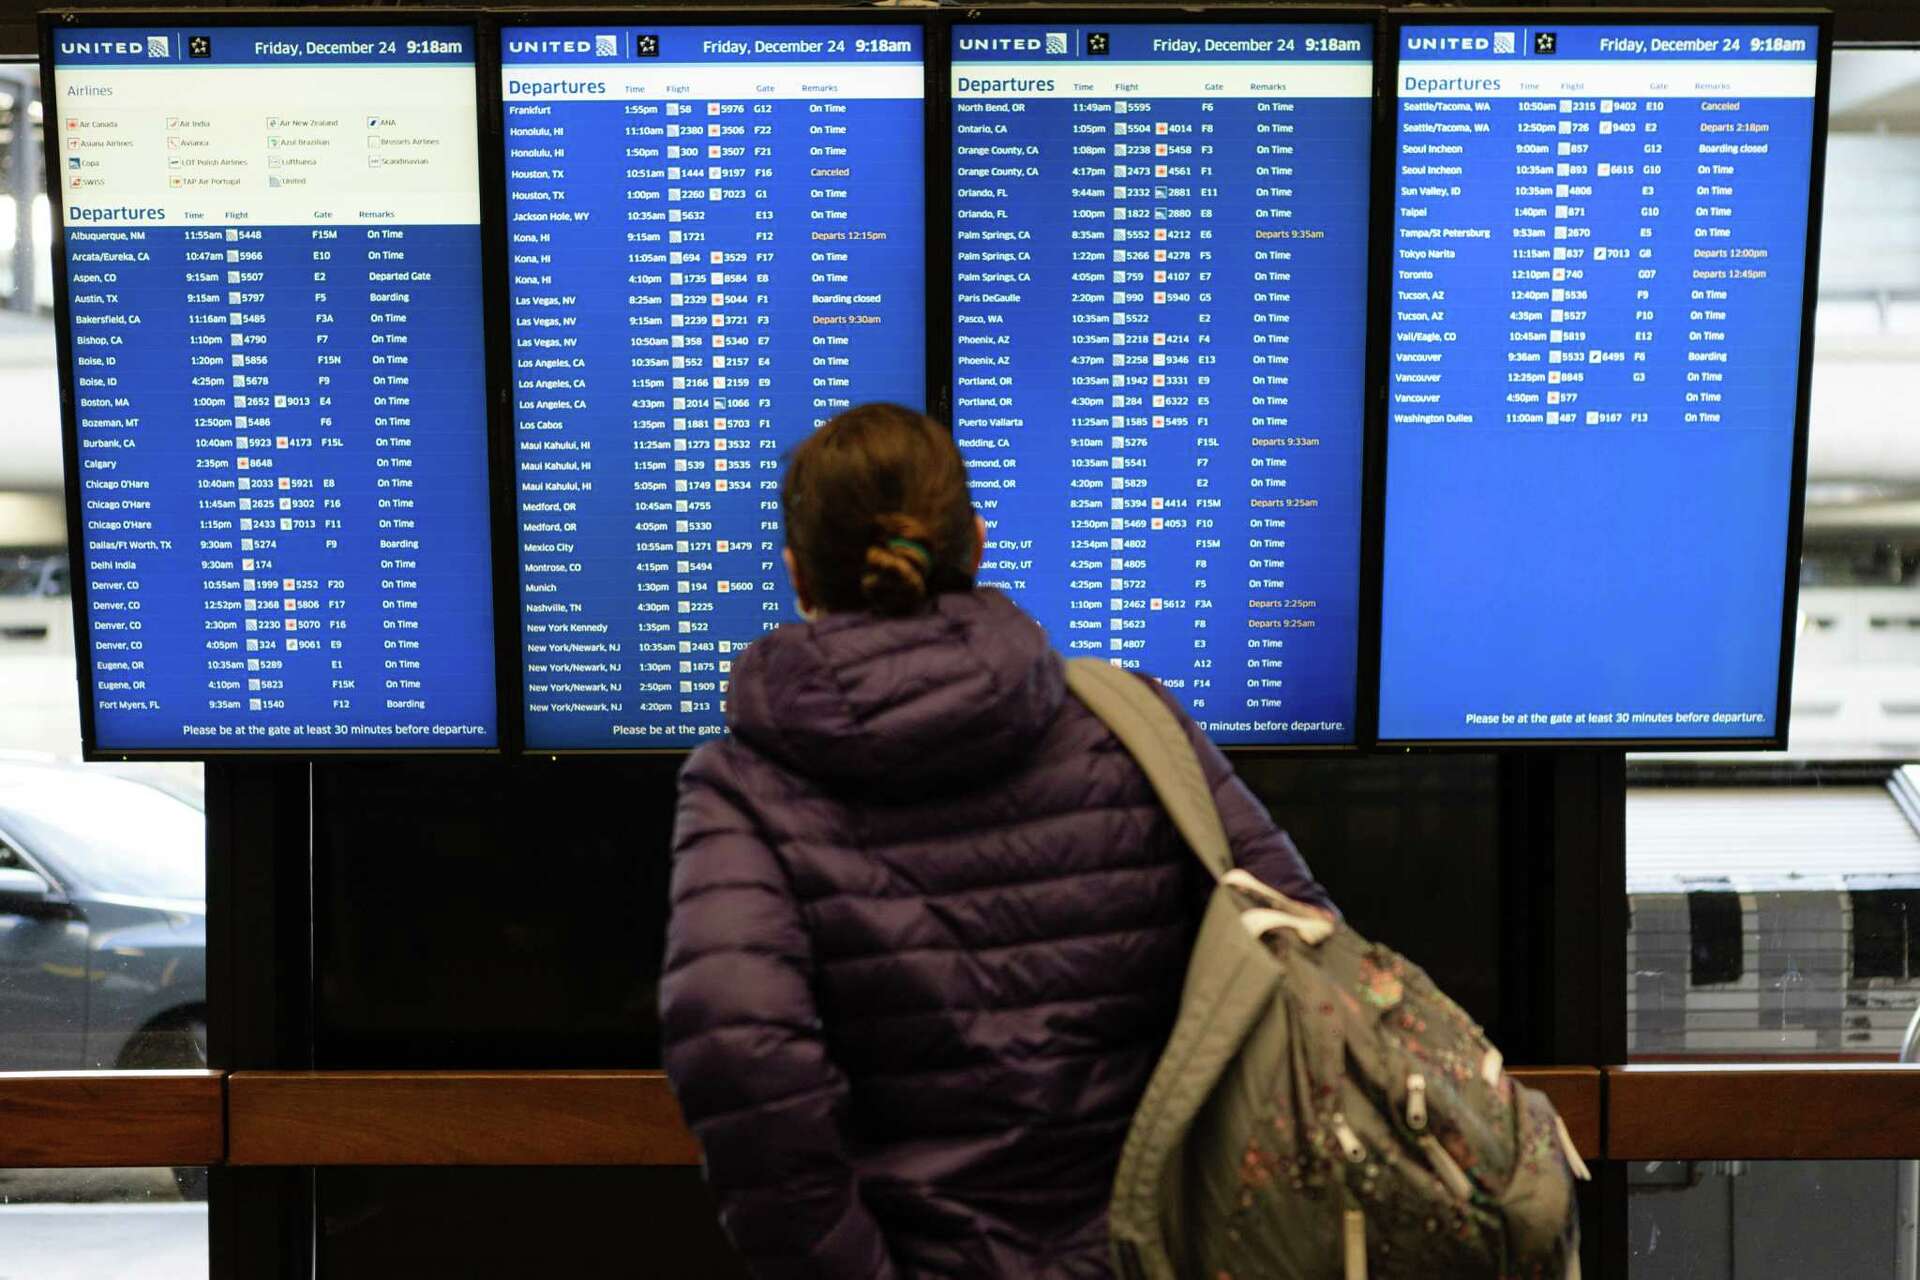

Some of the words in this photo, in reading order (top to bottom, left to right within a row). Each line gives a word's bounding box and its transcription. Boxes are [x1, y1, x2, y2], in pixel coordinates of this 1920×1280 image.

[255, 42, 302, 56] Friday,
[306, 42, 375, 54] December
[379, 42, 396, 53] 24
[407, 40, 462, 53] 9:18am
[509, 41, 591, 52] UNITED
[703, 41, 751, 55] Friday,
[755, 40, 822, 53] December
[827, 40, 845, 52] 24
[855, 40, 911, 52] 9:18am
[960, 39, 1041, 50] UNITED
[1153, 39, 1200, 53] Friday,
[1205, 39, 1273, 51] December
[1277, 39, 1295, 51] 24
[1305, 38, 1361, 51] 9:18am
[1408, 38, 1489, 49] UNITED
[1600, 38, 1647, 53] Friday,
[1651, 38, 1719, 51] December
[1723, 39, 1740, 51] 24
[1750, 38, 1806, 51] 9:18am
[62, 43, 143, 54] UNITED
[509, 80, 606, 96] Departures
[666, 85, 690, 94] Flight
[958, 78, 1055, 94] Departures
[1115, 83, 1139, 92] Flight
[1405, 77, 1501, 93] Departures
[67, 86, 113, 96] Airlines
[509, 106, 551, 114] Frankfurt
[625, 105, 658, 114] 1:55pm
[680, 105, 692, 113] 58
[721, 105, 744, 113] 5976
[754, 105, 772, 113] G12
[810, 104, 823, 112] On
[825, 104, 846, 112] Time
[1404, 102, 1473, 111] Seattle/Tacoma,
[1475, 102, 1491, 111] WA
[1519, 102, 1557, 111] 10:50am
[1572, 102, 1596, 111] 2315
[1614, 102, 1637, 110] 9402
[1646, 102, 1664, 110] E10
[510, 128, 551, 136] Honolulu,
[626, 127, 664, 135] 11:10am
[680, 127, 704, 135] 2380
[721, 126, 745, 134] 3506
[755, 126, 772, 134] F22
[810, 126, 823, 134] On
[958, 125, 992, 133] Ontario,
[995, 125, 1007, 133] CA
[1073, 125, 1106, 134] 1:05pm
[1169, 125, 1192, 133] 4014
[1257, 124, 1270, 132] On
[1272, 124, 1293, 132] Time
[958, 168, 990, 177] Orange
[992, 168, 1025, 177] County,
[1072, 167, 1105, 176] 4:17pm
[1127, 167, 1151, 175] 2473
[1168, 167, 1191, 175] 4561
[1202, 167, 1213, 175] F1
[1256, 167, 1269, 175] On
[1271, 167, 1292, 175] Time
[69, 207, 165, 222] Departures
[71, 232, 127, 241] Albuquerque,
[185, 231, 222, 239] 11:55am
[238, 231, 262, 239] 5448
[313, 230, 337, 239] F15M
[367, 230, 381, 238] On
[383, 230, 403, 238] Time
[811, 232, 846, 240] Departs
[849, 232, 887, 240] 12:15pm
[72, 252, 137, 262] Arcata/Eureka,
[139, 252, 149, 260] CA
[186, 252, 224, 260] 10:47am
[239, 252, 263, 260] 5966
[313, 251, 331, 260] E10
[368, 251, 381, 259] On
[384, 251, 404, 259] Time
[1398, 291, 1431, 300] Tucson,
[1433, 291, 1444, 299] AZ
[1512, 291, 1549, 300] 12:40pm
[1692, 290, 1704, 299] On
[1707, 290, 1727, 299] Time
[92, 582, 124, 590] Denver,
[127, 581, 139, 589] CO
[203, 581, 240, 589] 10:55am
[257, 581, 279, 589] 1999
[296, 580, 319, 589] 5252
[328, 580, 344, 588] F20
[381, 580, 394, 588] On
[396, 580, 417, 588] Time
[548, 624, 568, 632] York
[570, 624, 608, 633] Kennedy
[639, 623, 670, 632] 1:35pm
[692, 623, 708, 631] 522
[1466, 714, 1499, 723] Please
[1502, 714, 1514, 723] be
[1517, 714, 1527, 723] at
[1530, 713, 1547, 723] the
[1550, 714, 1573, 724] gate
[1576, 714, 1585, 723] at
[1588, 713, 1613, 723] least
[1616, 713, 1629, 723] 30
[1632, 713, 1673, 722] minutes
[1676, 712, 1709, 722] before
[1712, 712, 1765, 723] departure.
[183, 725, 216, 735] Please
[220, 725, 232, 734] be
[235, 726, 245, 734] at
[247, 725, 265, 734] the
[268, 726, 292, 736] gate
[294, 726, 304, 734] at
[307, 725, 331, 734] least
[334, 725, 348, 734] 30
[351, 725, 392, 734] minutes
[395, 724, 430, 734] before
[432, 724, 486, 735] departure.
[613, 725, 646, 734] Please
[650, 725, 662, 734] be
[666, 726, 675, 734] at
[678, 725, 696, 734] the
[698, 725, 720, 735] gate
[1210, 721, 1250, 731] minutes
[1253, 721, 1287, 730] before
[1290, 720, 1344, 731] departure.
